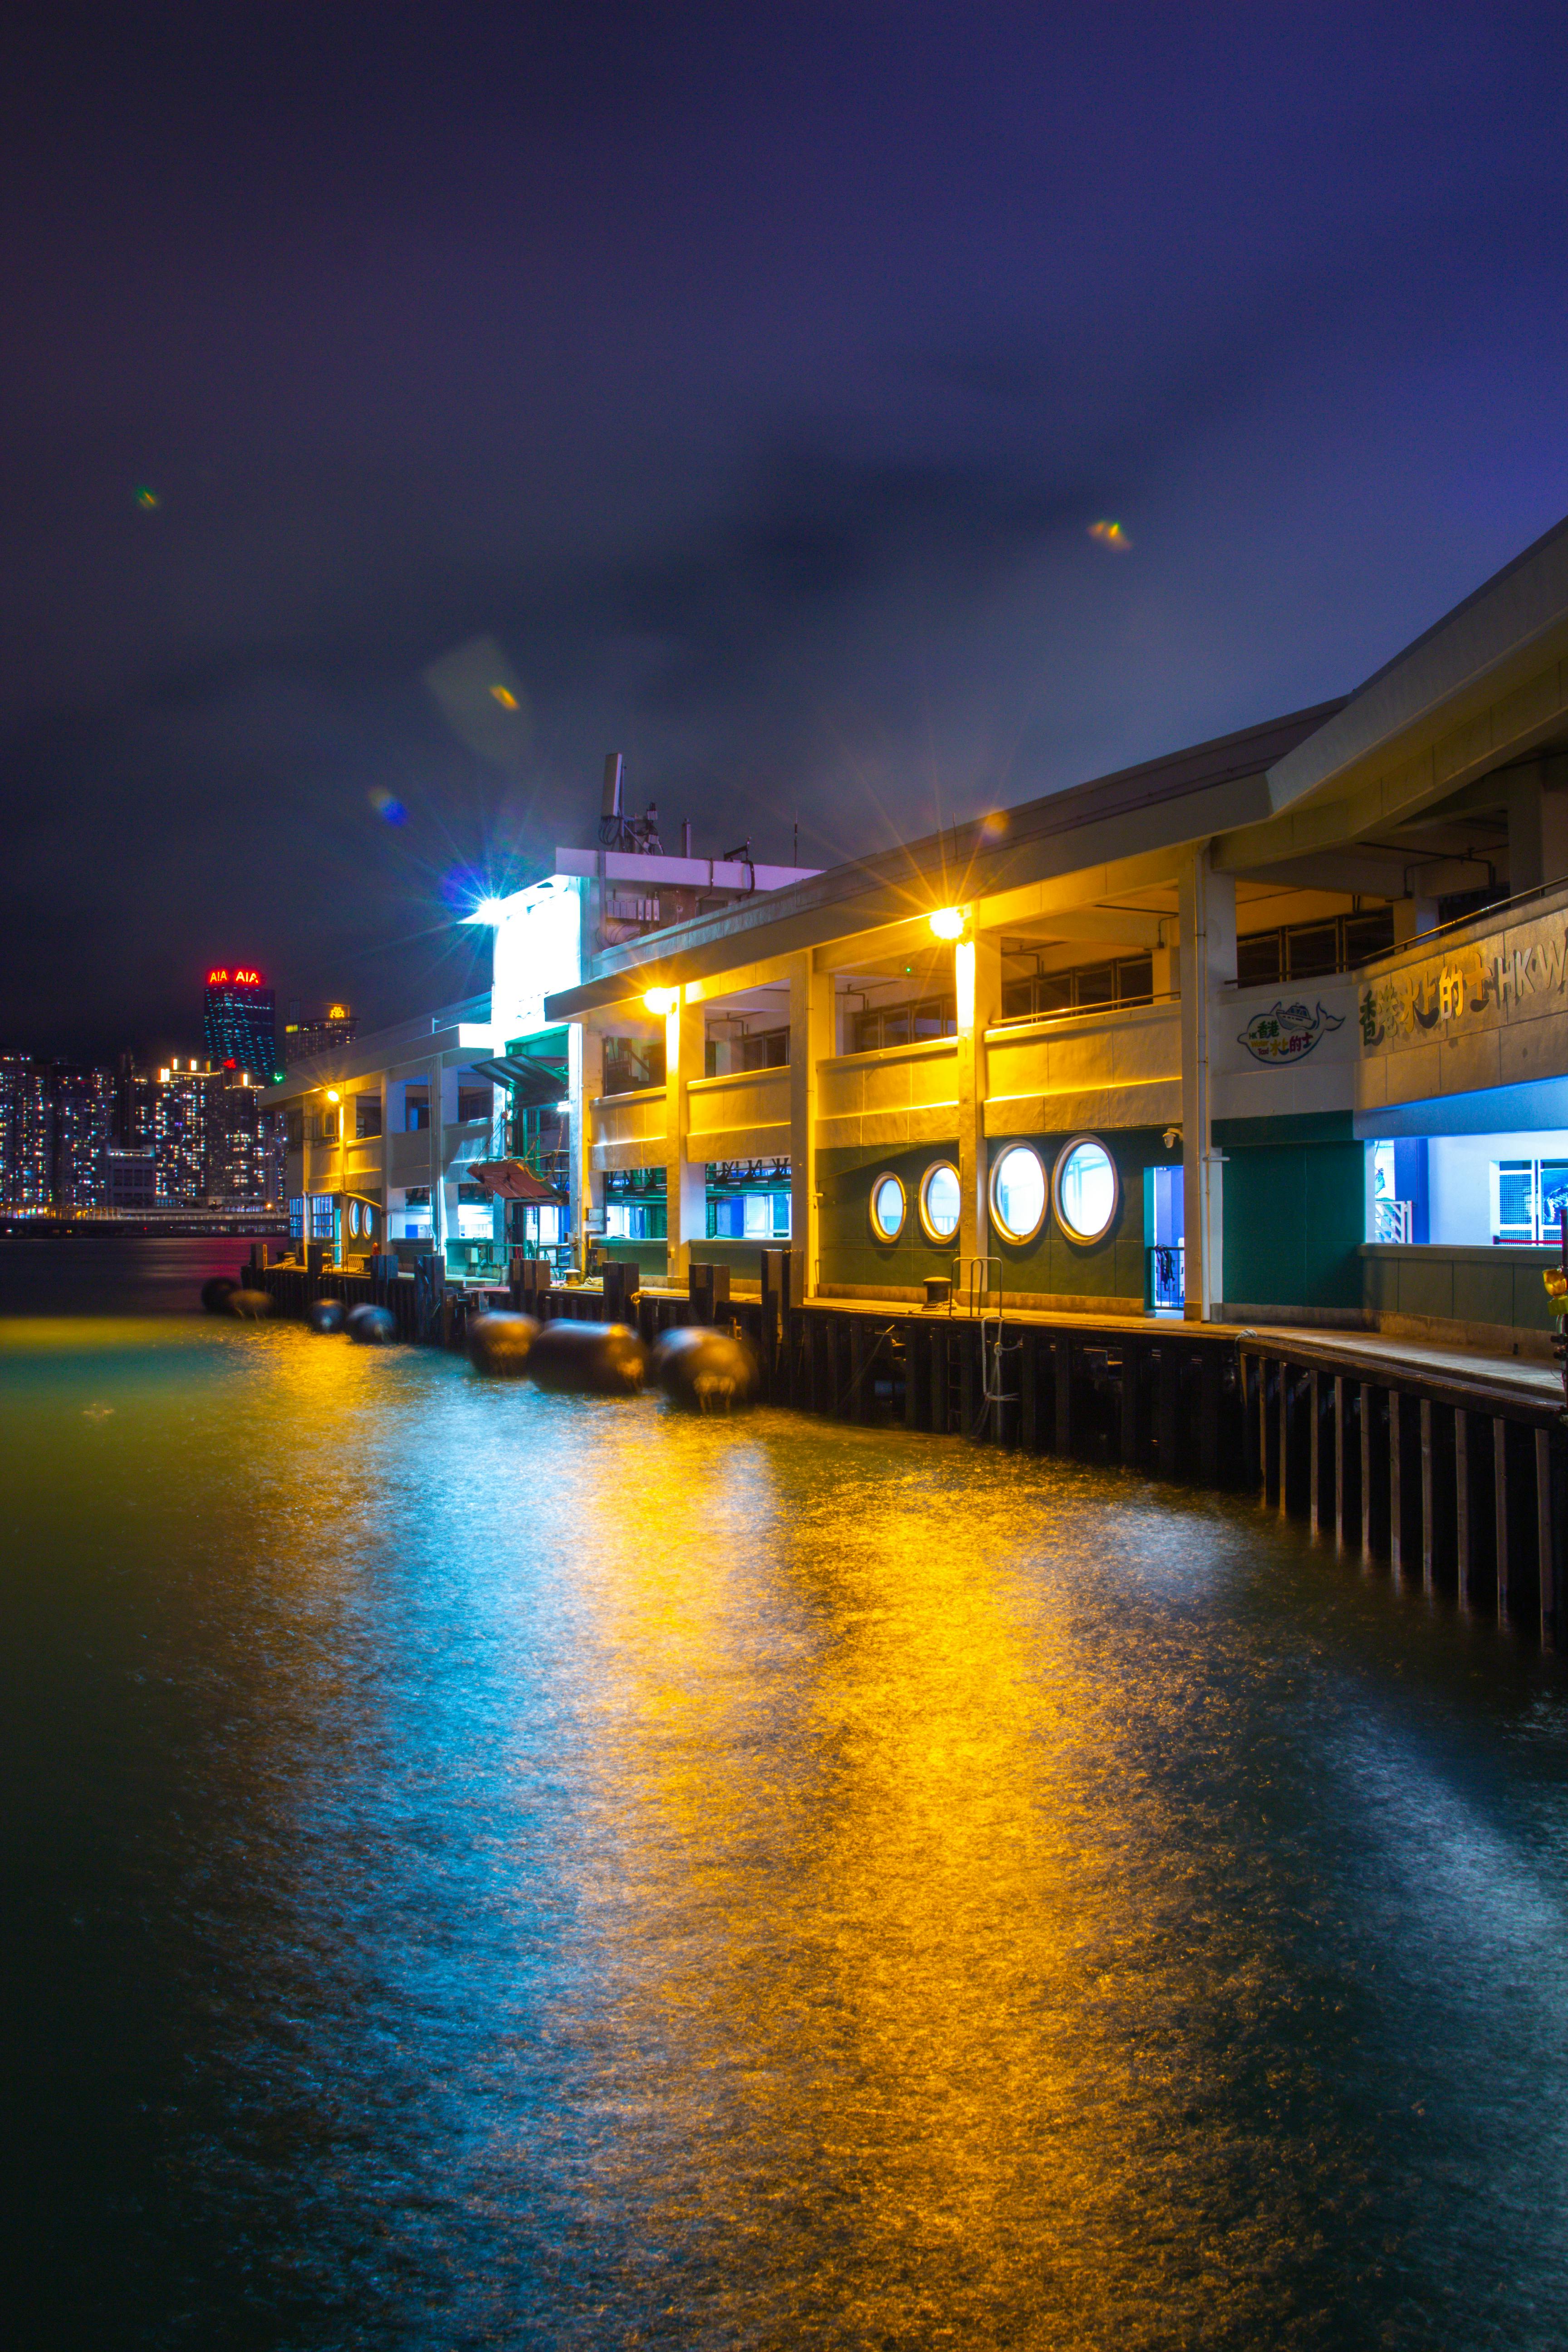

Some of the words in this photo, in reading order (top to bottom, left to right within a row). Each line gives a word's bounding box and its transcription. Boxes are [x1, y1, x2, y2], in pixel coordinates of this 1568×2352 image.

[1498, 946, 1535, 1001] HK
[1537, 936, 1568, 989] W
[210, 971, 227, 982] AIA
[236, 971, 259, 983] AIA
[1257, 1020, 1280, 1039] 香港
